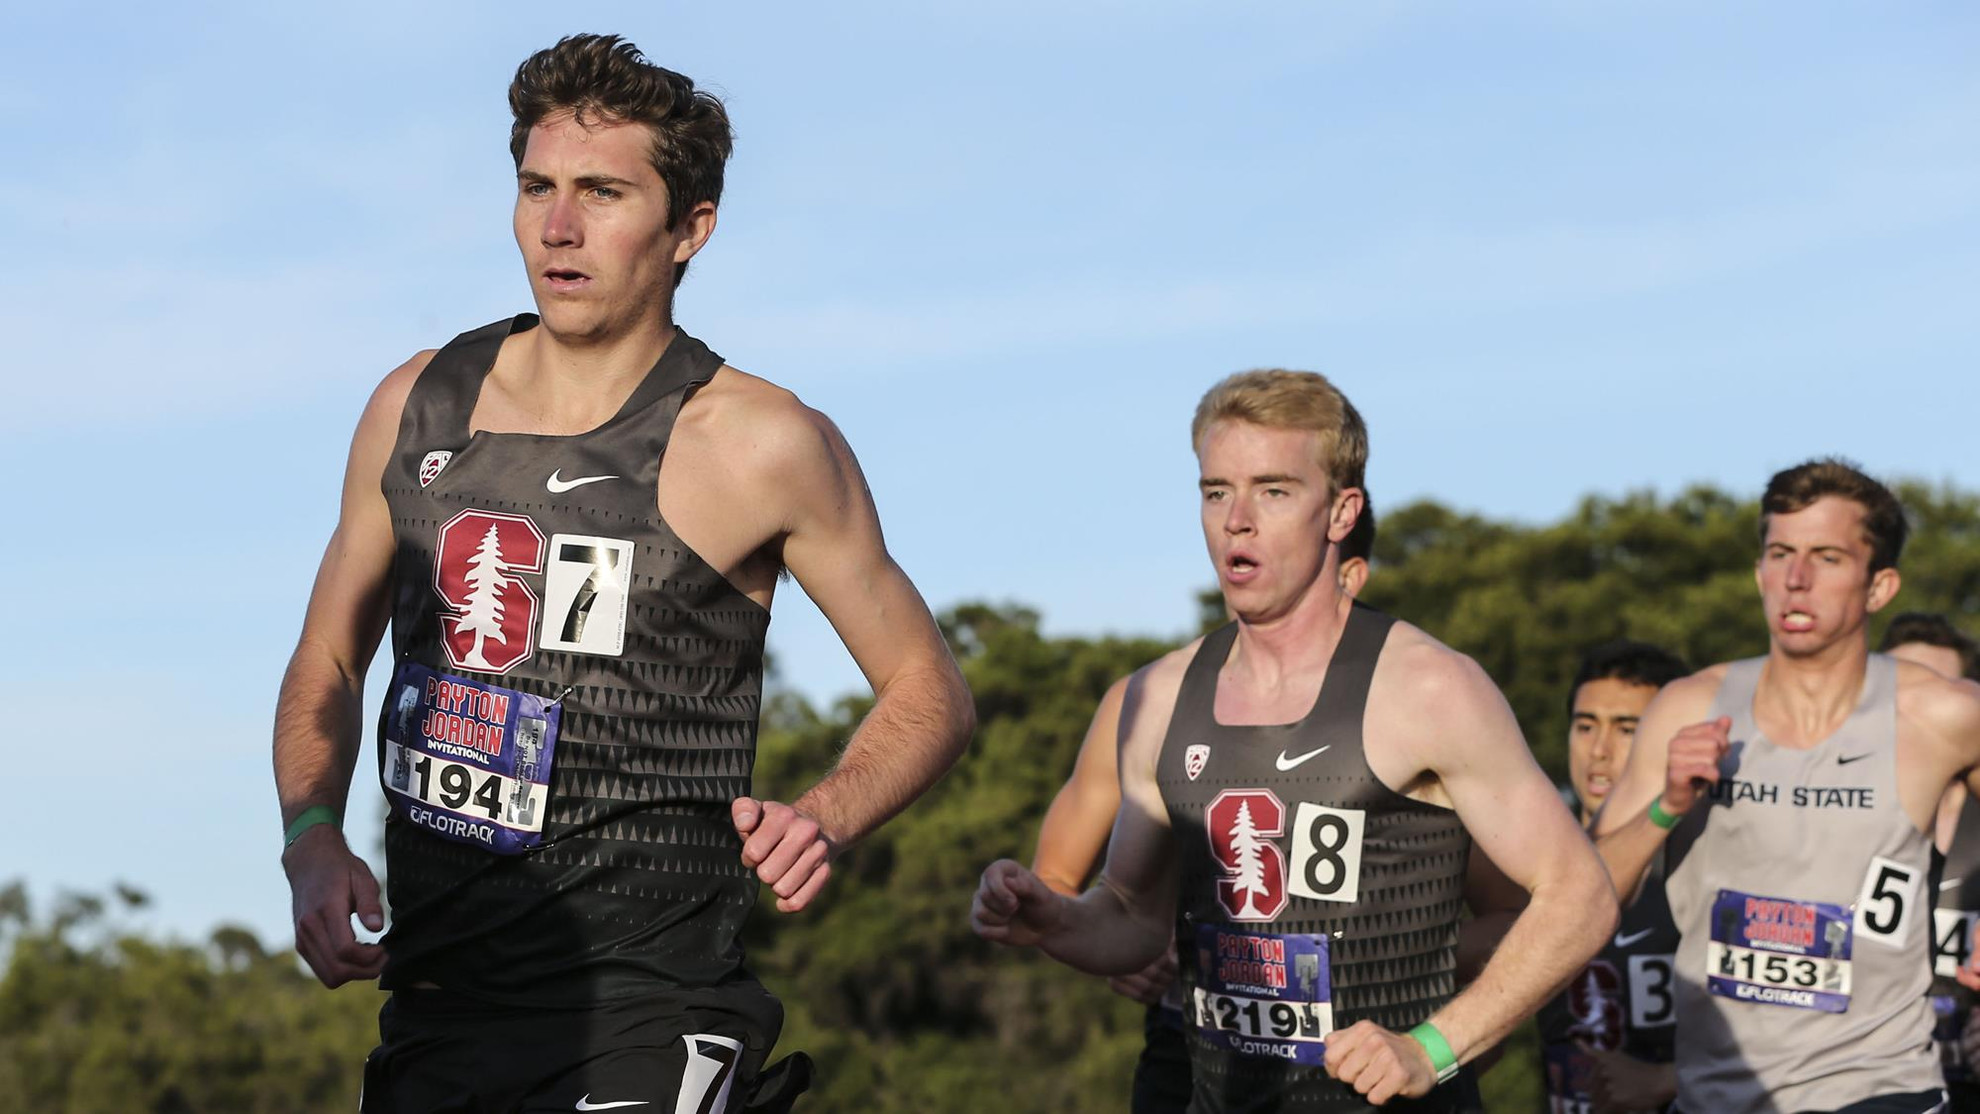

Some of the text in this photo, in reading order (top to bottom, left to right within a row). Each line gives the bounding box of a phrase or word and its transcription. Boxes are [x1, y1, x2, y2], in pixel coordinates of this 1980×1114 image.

[559, 544, 620, 643] 7
[425, 676, 510, 725] PAYTON
[422, 710, 504, 757] JORDAN
[428, 739, 490, 765] INVITATIONAL
[415, 756, 502, 821] 194
[1793, 785, 1874, 808] STATE
[419, 810, 496, 845] FLOTRACK
[1304, 813, 1349, 895] 8
[1865, 865, 1911, 935] 5
[1217, 932, 1286, 964] PAYTON
[1936, 917, 1969, 968] 4
[1218, 959, 1288, 990] JORDAN
[1641, 960, 1673, 1022] 3
[1741, 953, 1818, 986] 153
[1216, 997, 1298, 1038] 219
[695, 1039, 737, 1114] 7
